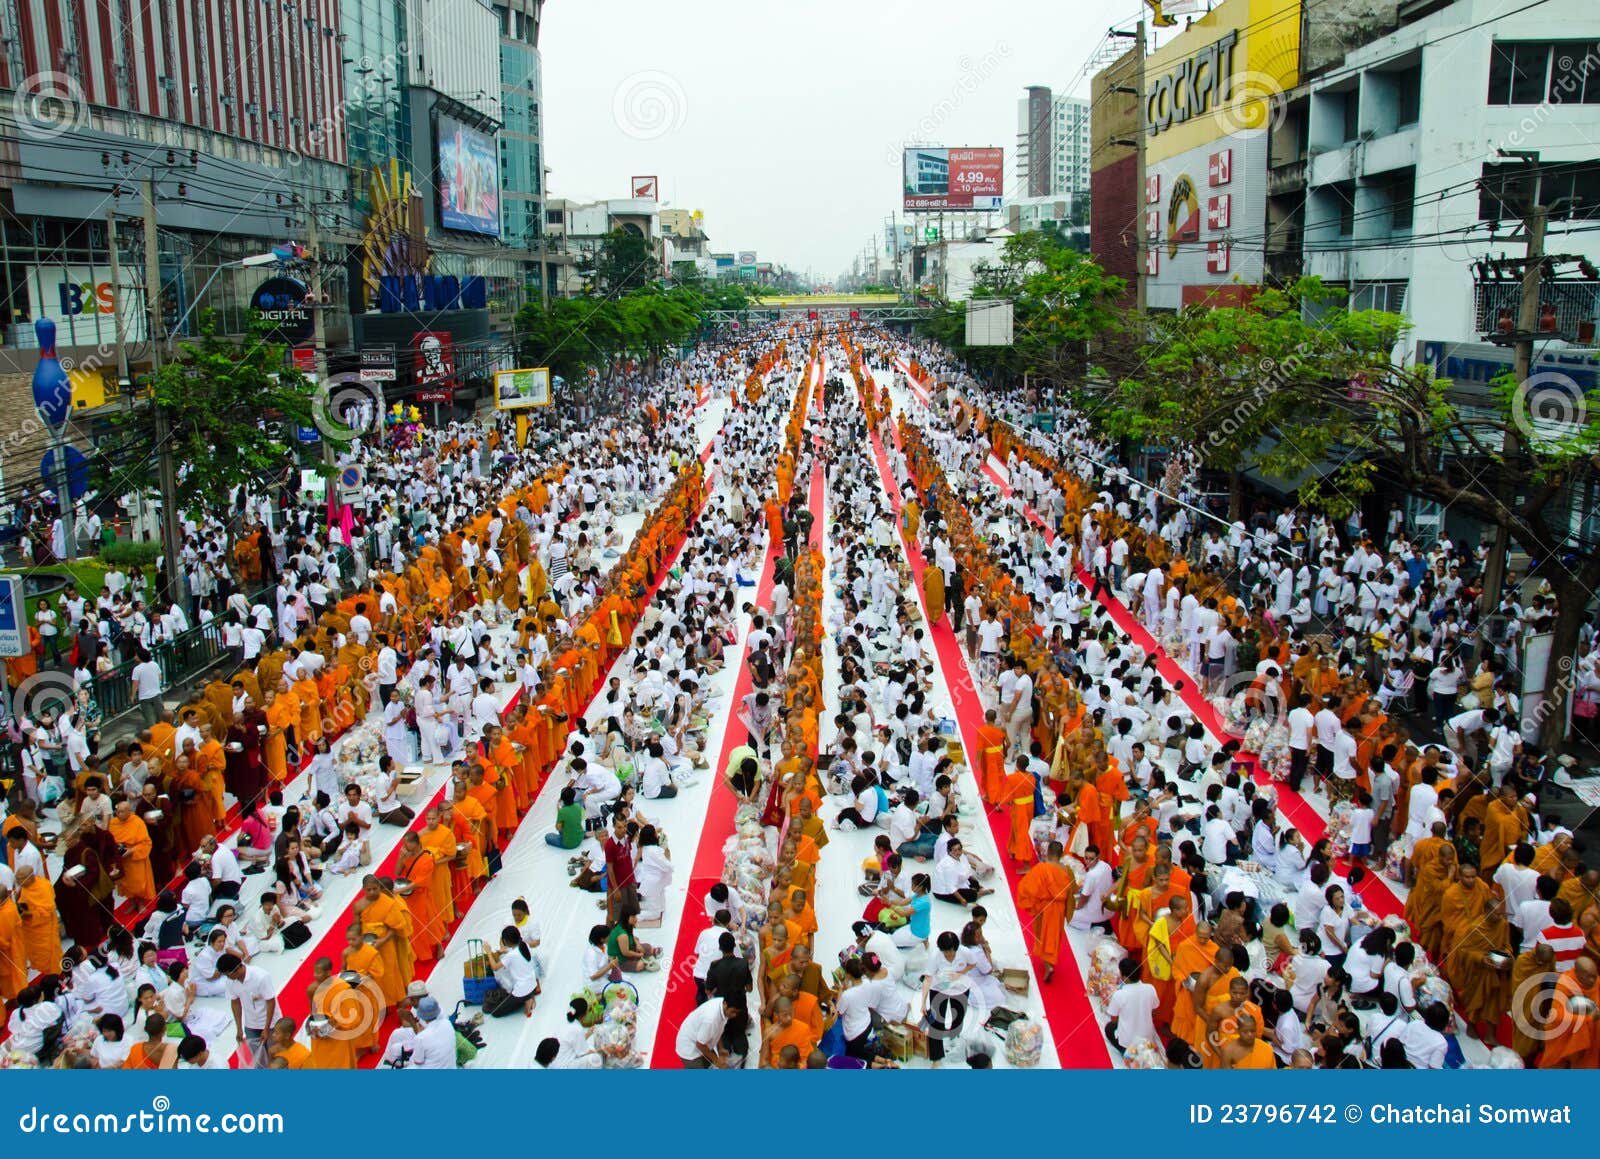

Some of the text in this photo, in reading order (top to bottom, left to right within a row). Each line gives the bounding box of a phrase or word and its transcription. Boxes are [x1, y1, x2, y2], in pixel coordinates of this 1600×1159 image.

[1145, 28, 1238, 137] COCKPIT
[956, 171, 984, 183] 4.99
[58, 281, 115, 316] B2S
